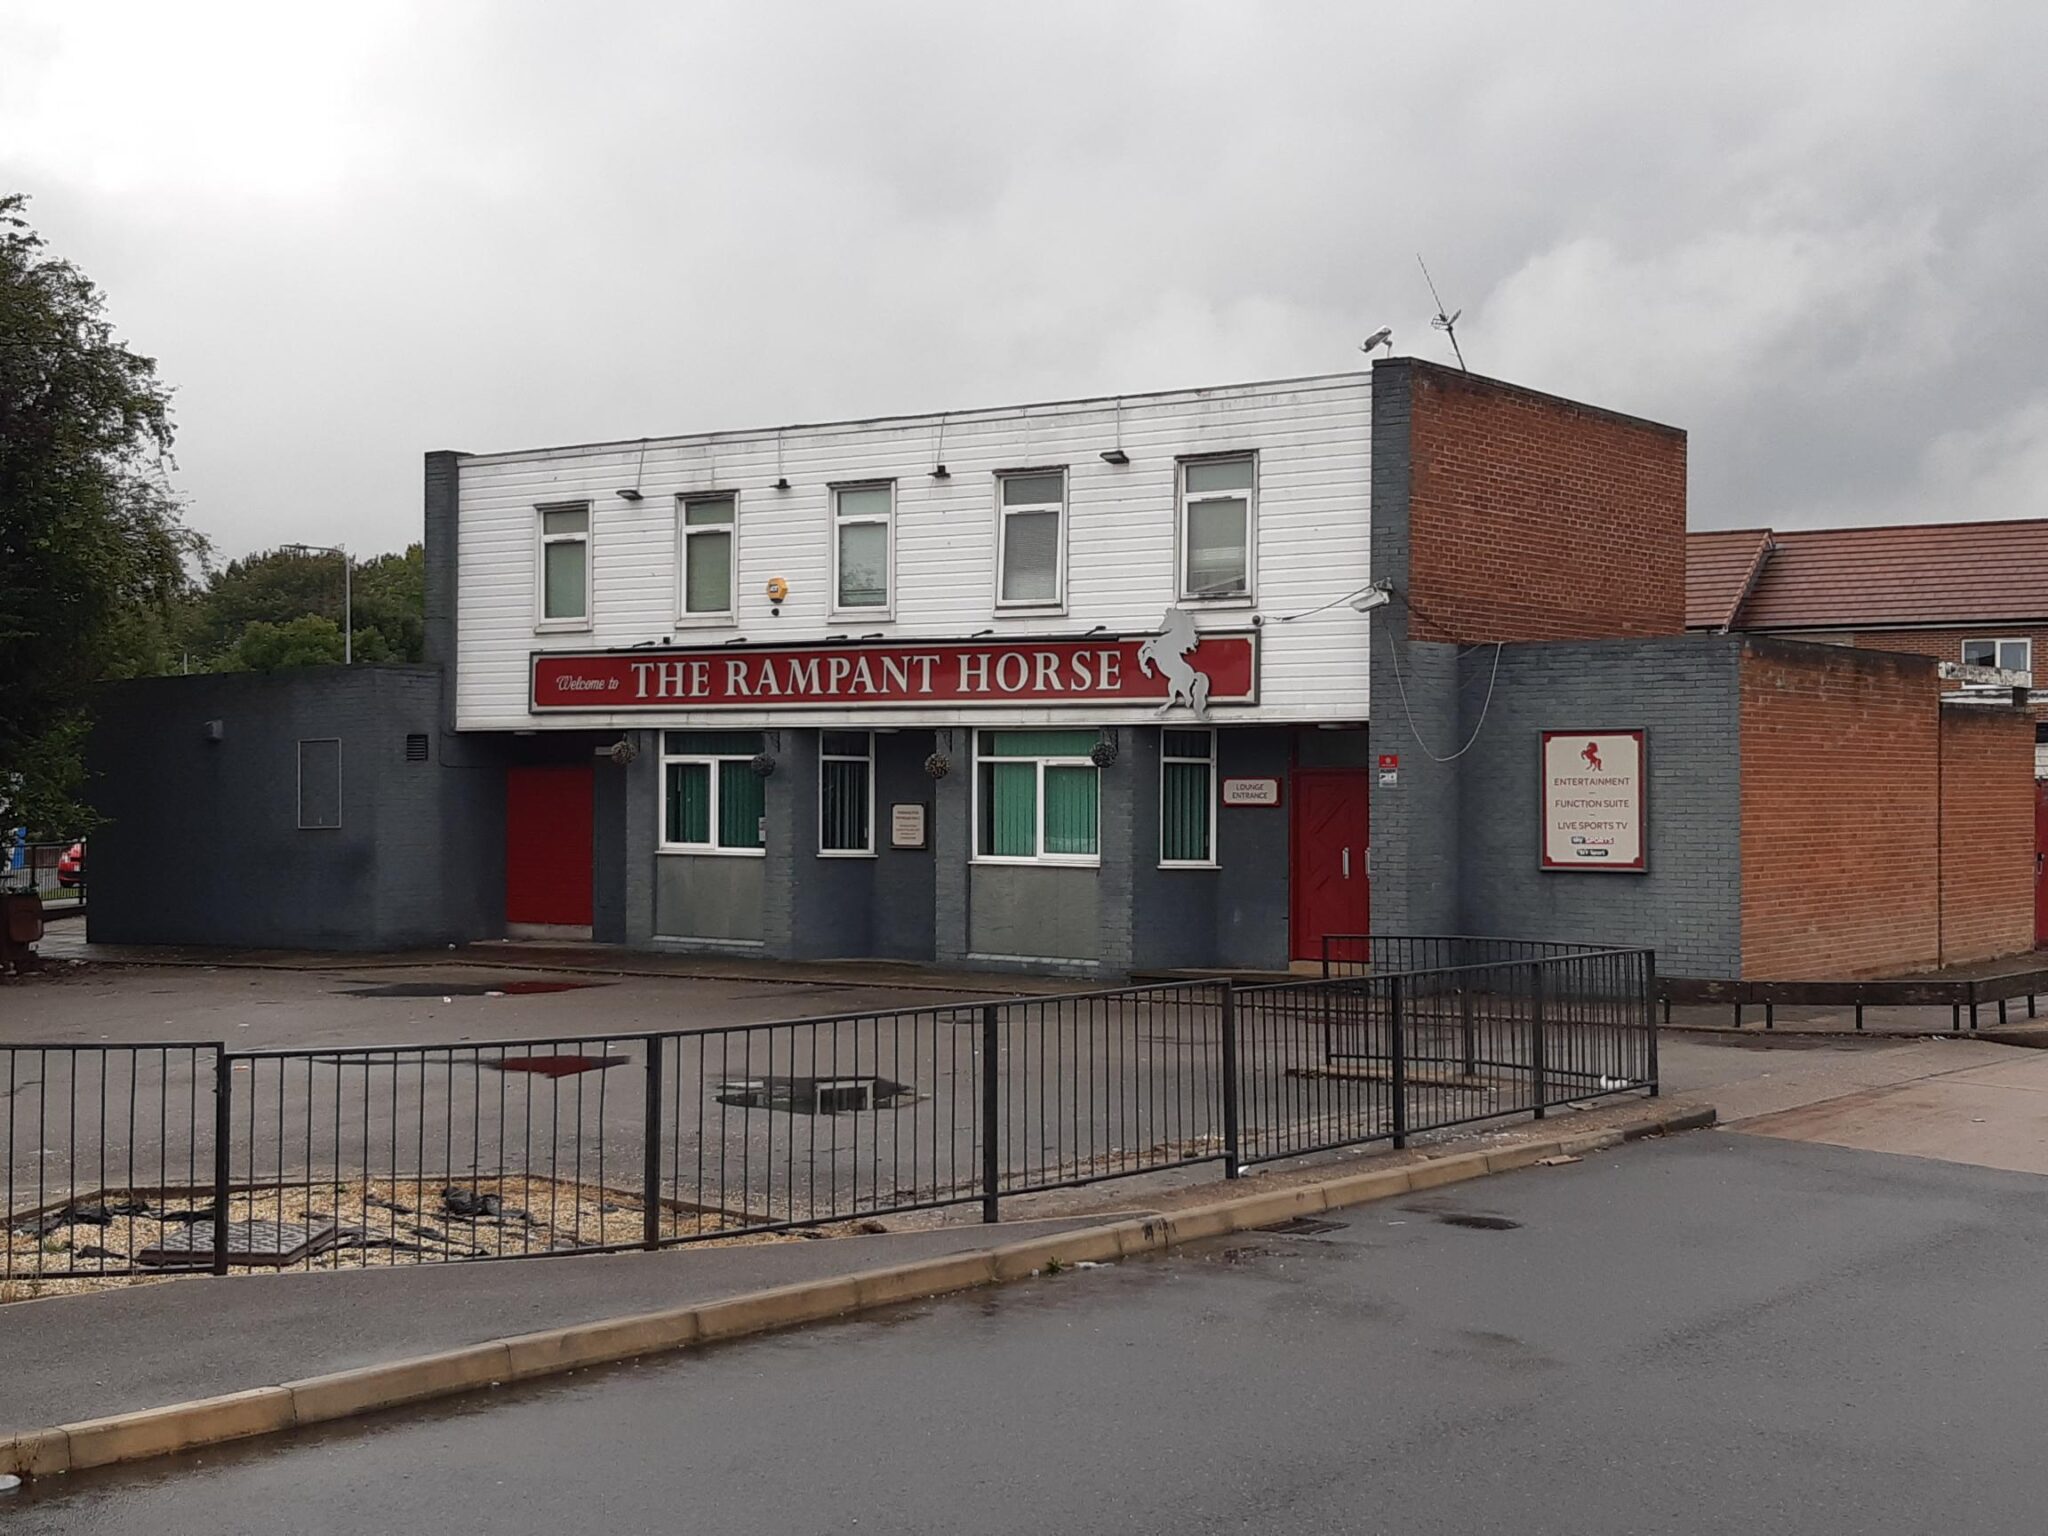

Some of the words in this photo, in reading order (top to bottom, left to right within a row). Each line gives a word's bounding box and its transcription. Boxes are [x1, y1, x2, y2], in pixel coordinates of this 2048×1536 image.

[556, 675, 605, 691] Welcome
[608, 676, 619, 690] to
[631, 660, 710, 698] THE
[723, 655, 940, 697] RAMPANT
[956, 650, 1123, 693] HORSE
[1554, 777, 1630, 786] ENTERTAINMENT
[1235, 783, 1264, 791] LOUNGE
[1232, 792, 1267, 800] ENTRANCE
[1555, 800, 1601, 808] FUNCTION
[1603, 799, 1630, 808] SUITE
[1557, 822, 1578, 830] LIVE
[1579, 822, 1614, 830] SPORTS
[1616, 822, 1628, 830] TV
